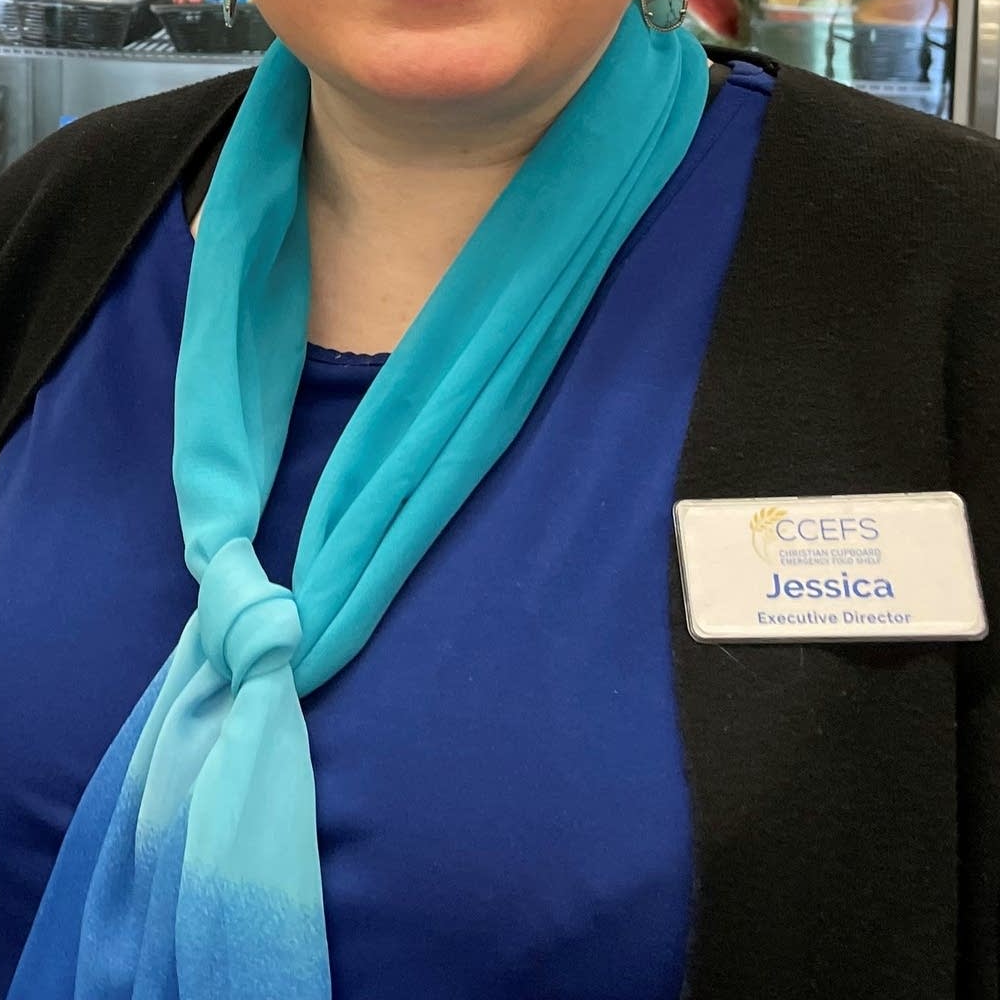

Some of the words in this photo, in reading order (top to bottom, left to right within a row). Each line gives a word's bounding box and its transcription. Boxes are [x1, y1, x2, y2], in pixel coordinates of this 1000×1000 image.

[776, 517, 879, 541] CCEFS
[767, 572, 894, 599] Jessica
[758, 611, 837, 625] Executive
[844, 611, 911, 624] Director
